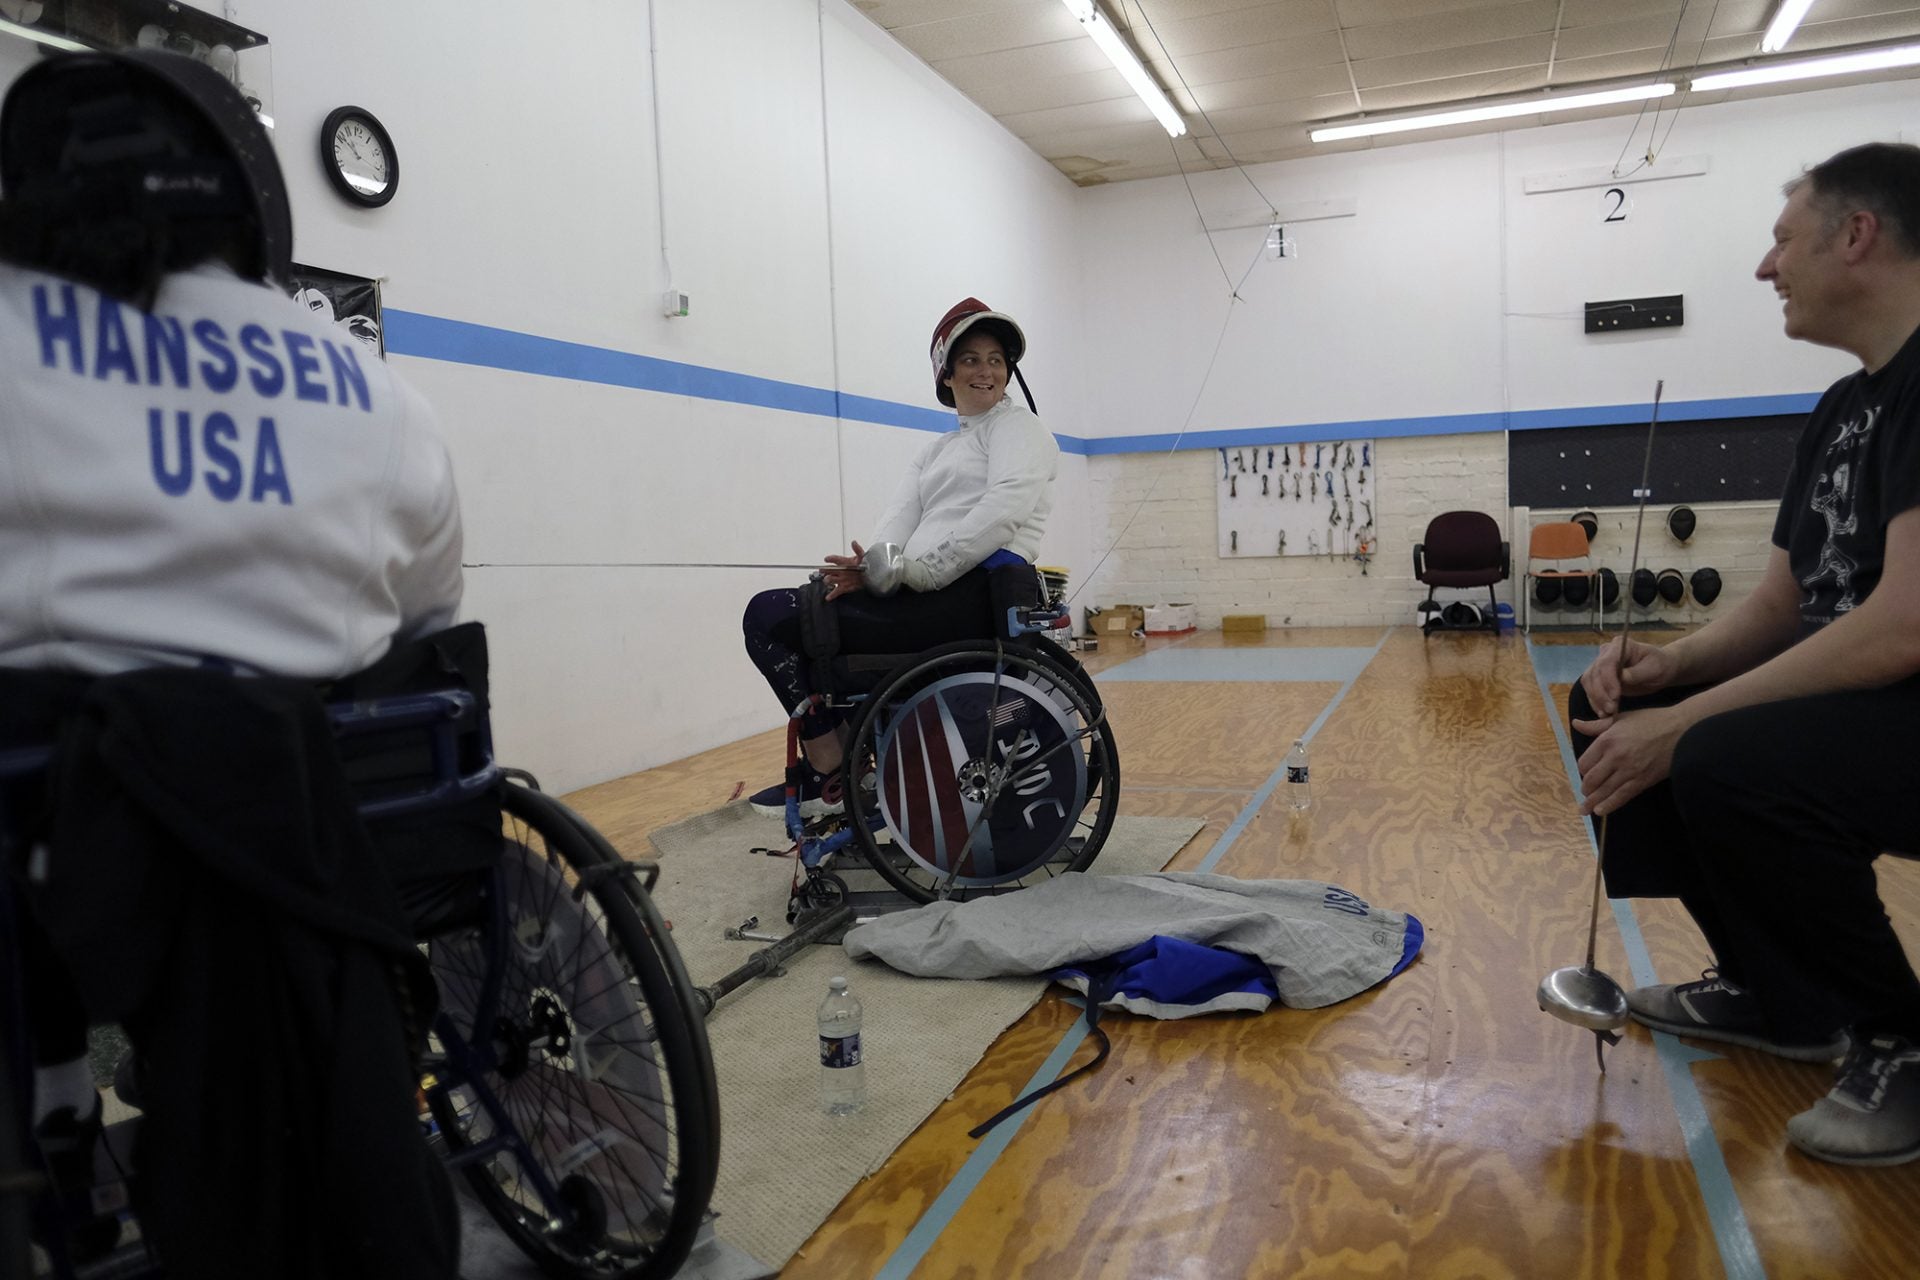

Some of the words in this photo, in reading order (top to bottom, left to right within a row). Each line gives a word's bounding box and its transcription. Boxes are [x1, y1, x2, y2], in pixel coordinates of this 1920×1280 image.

[1603, 187, 1627, 222] 2
[1274, 226, 1287, 258] 1
[33, 283, 373, 412] HANSSEN
[147, 406, 294, 505] USA
[1323, 886, 1370, 916] USA
